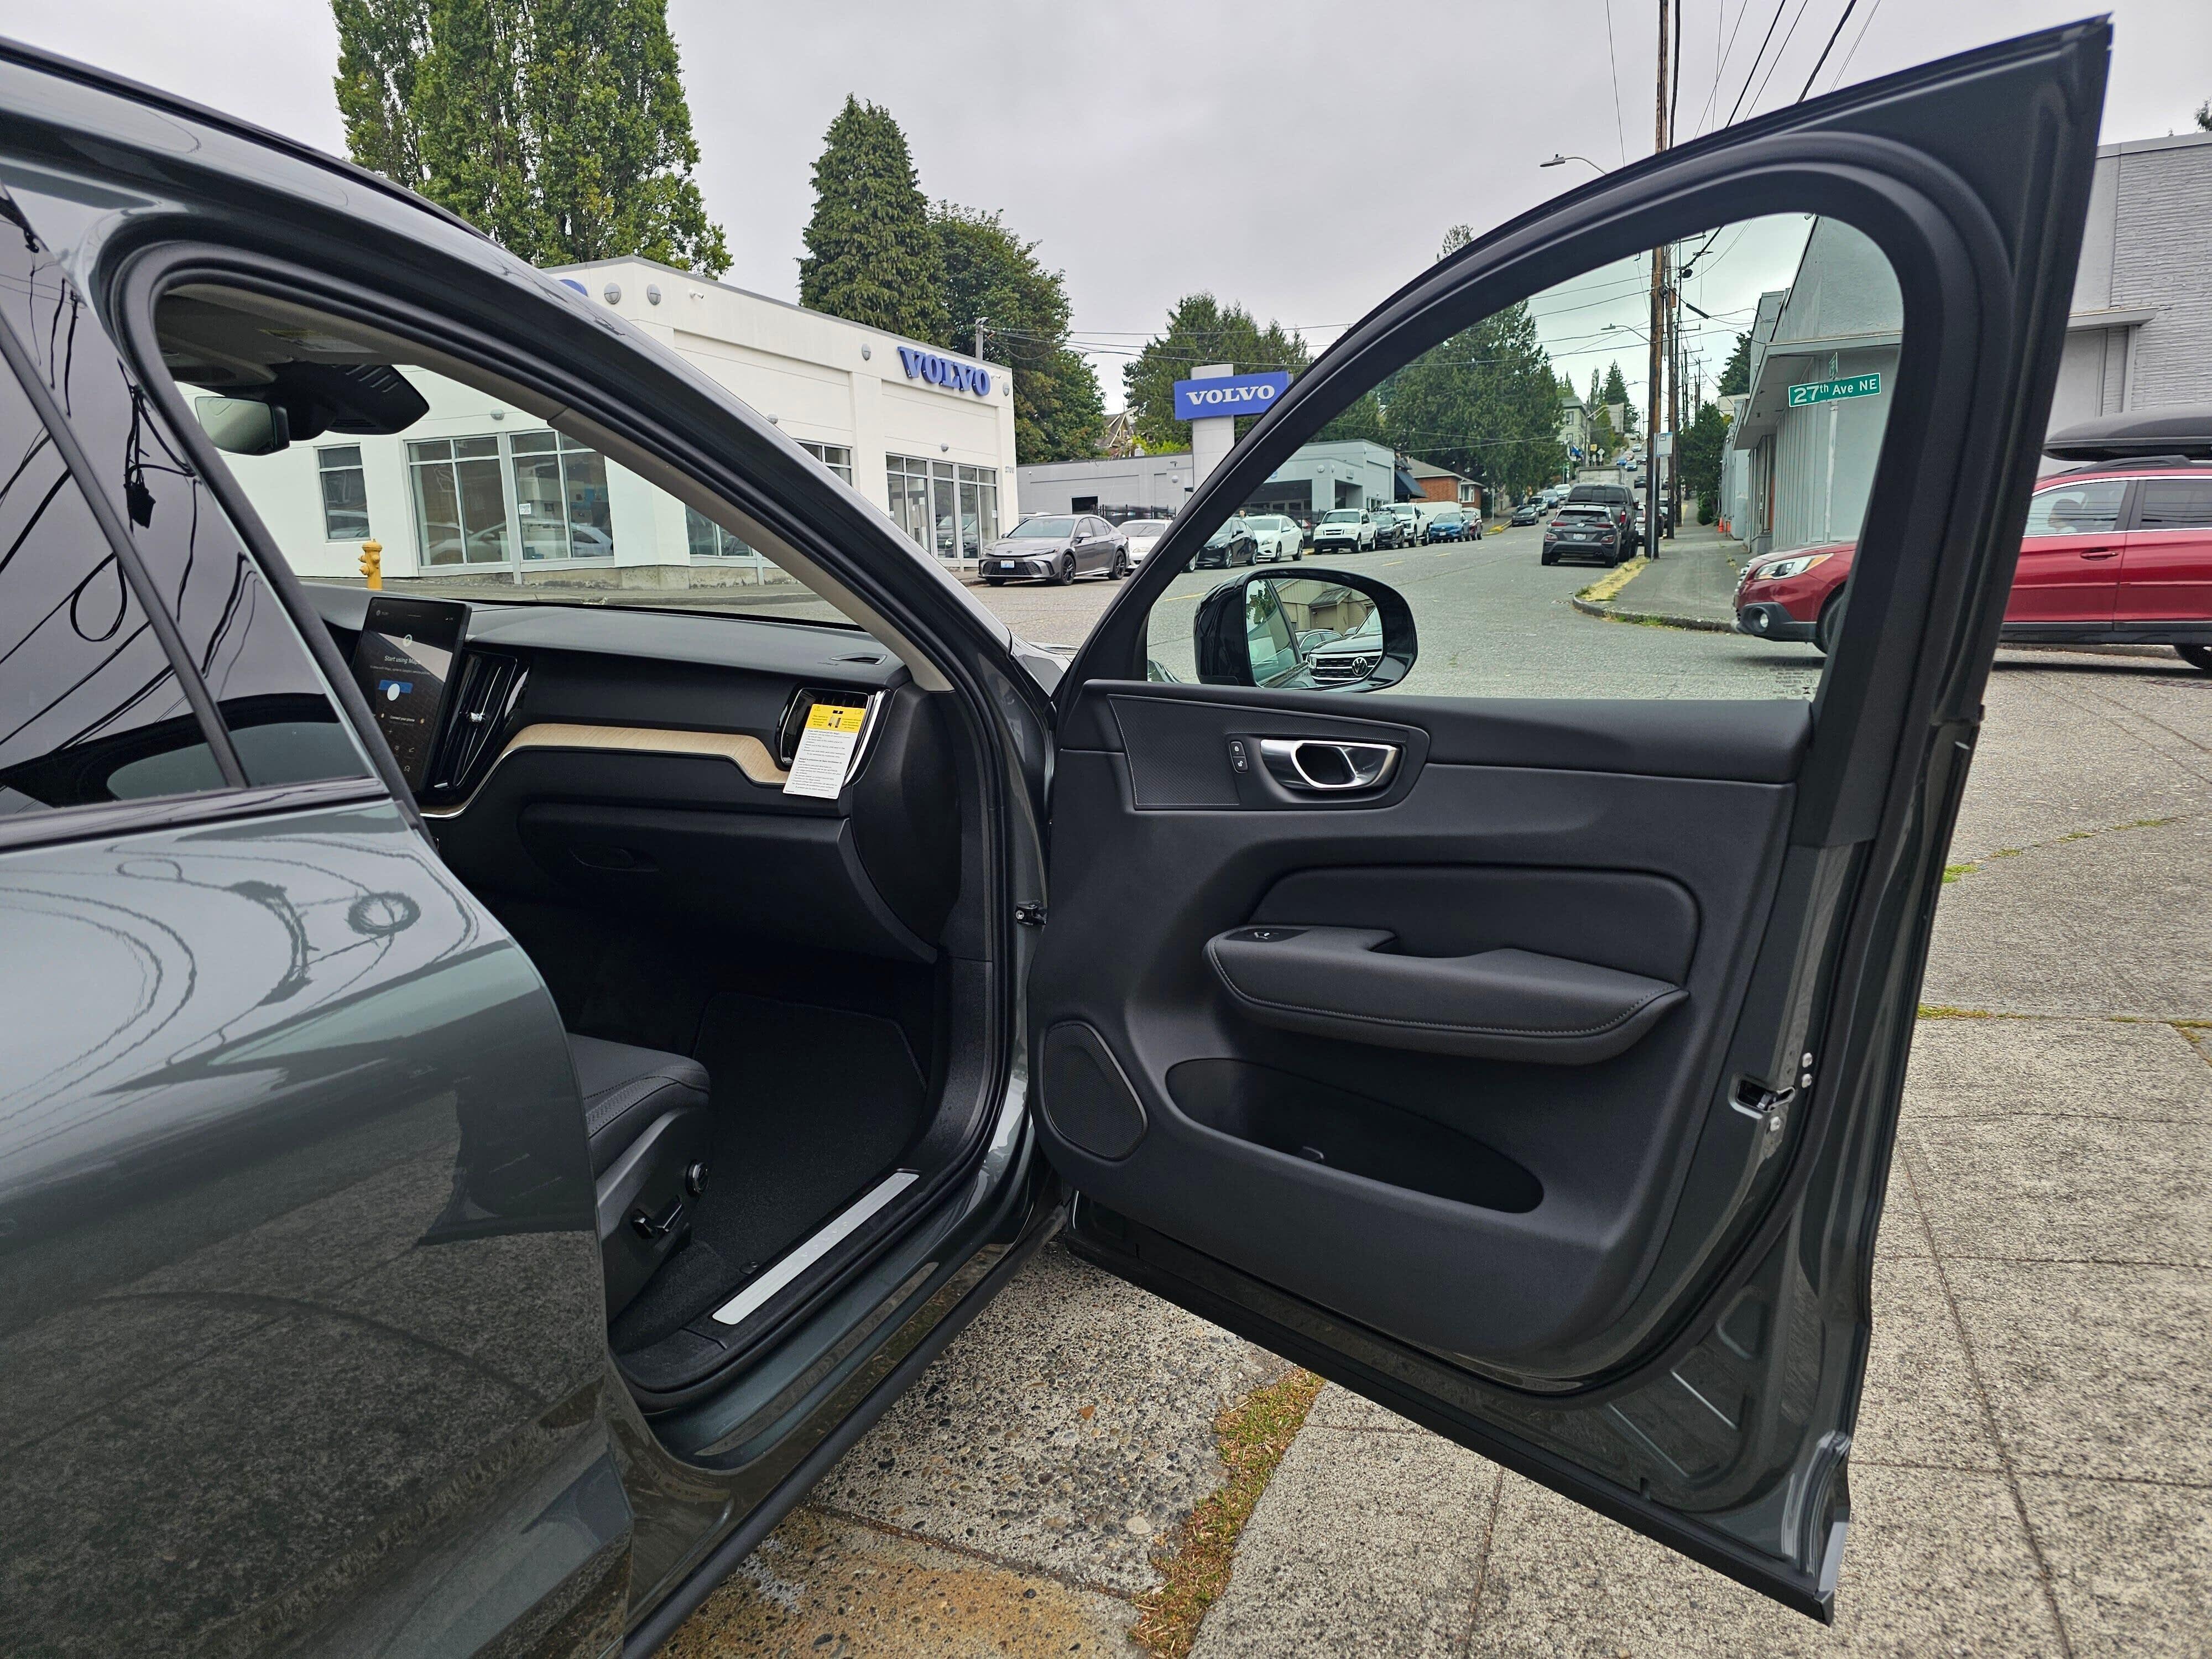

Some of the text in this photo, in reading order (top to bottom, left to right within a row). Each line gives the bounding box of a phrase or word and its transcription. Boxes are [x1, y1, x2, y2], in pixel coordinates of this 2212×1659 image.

[897, 346, 991, 396] VOLVO
[1186, 385, 1275, 405] VOLVO
[1794, 379, 1877, 403] 27th Ave NE
